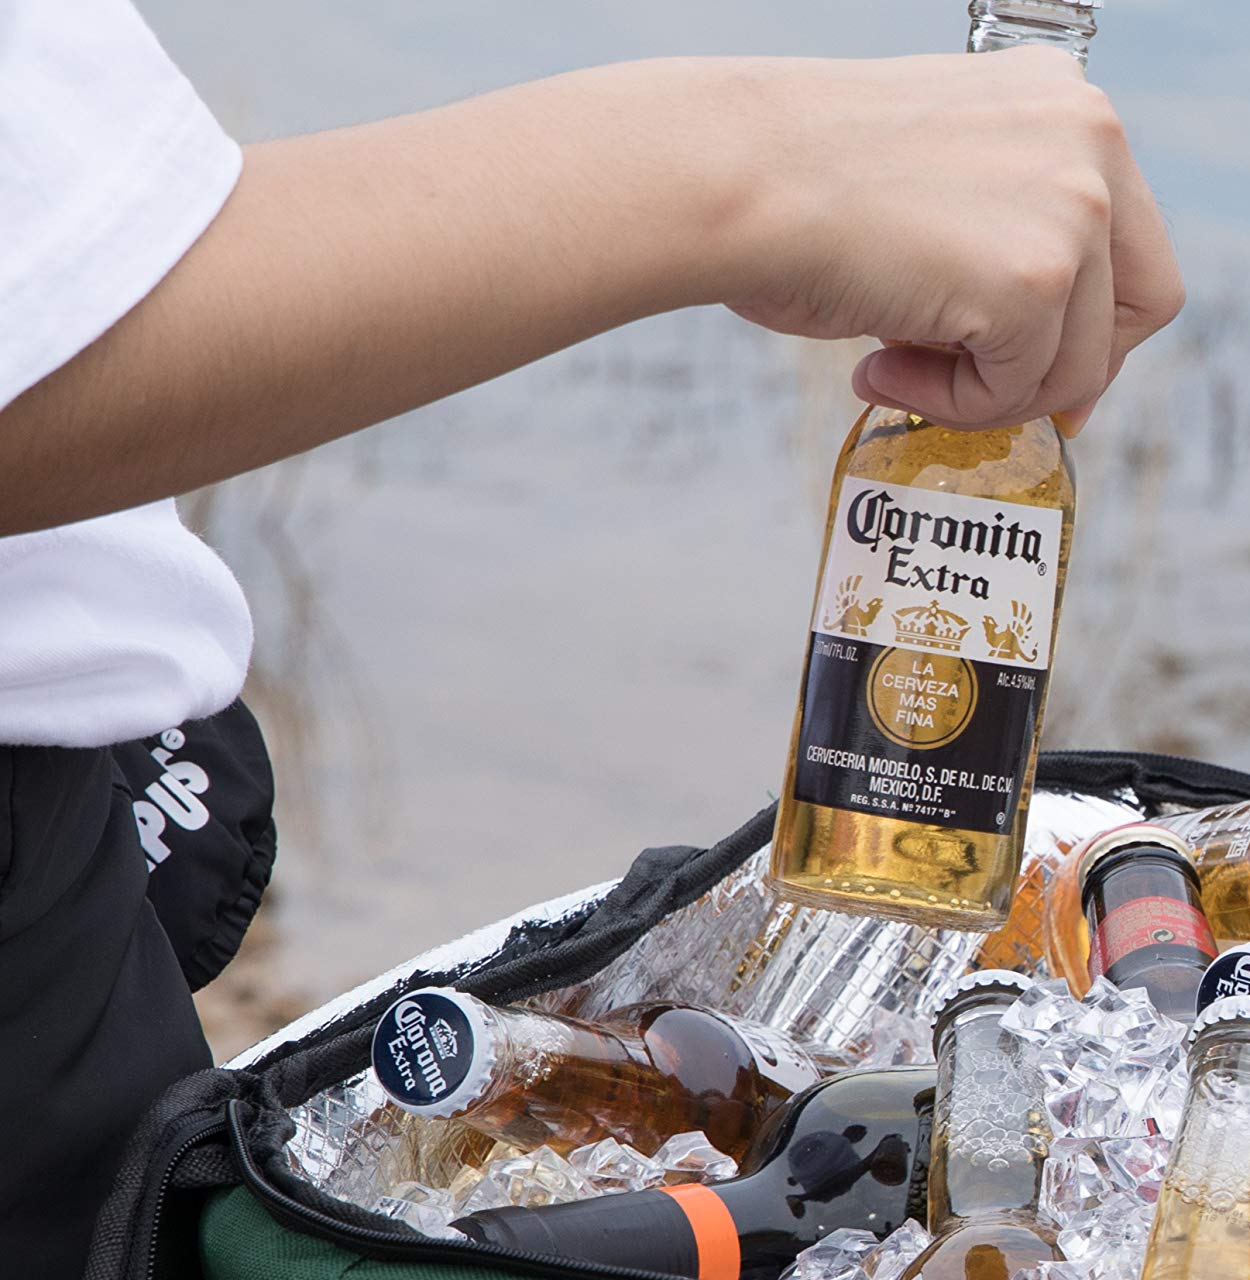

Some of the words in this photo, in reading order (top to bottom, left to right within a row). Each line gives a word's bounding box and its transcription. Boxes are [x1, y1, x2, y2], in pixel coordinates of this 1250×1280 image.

[885, 545, 990, 600] Extra
[912, 661, 934, 677] LA
[882, 673, 959, 698] CERVEZA
[900, 693, 937, 711] MAS
[895, 710, 935, 729] FINA
[806, 745, 866, 771] CERVECERIA
[868, 756, 923, 784] MODELO,
[940, 768, 957, 787] DE
[982, 774, 997, 793] DE
[869, 776, 920, 802] MEXICO,
[922, 784, 943, 804] D.F.
[132, 746, 210, 874] PUS
[850, 793, 870, 807] REG.
[872, 797, 900, 811] S.S.A.
[914, 803, 938, 817] 7417
[388, 1035, 415, 1091] Extra
[394, 1001, 447, 1097] Corona
